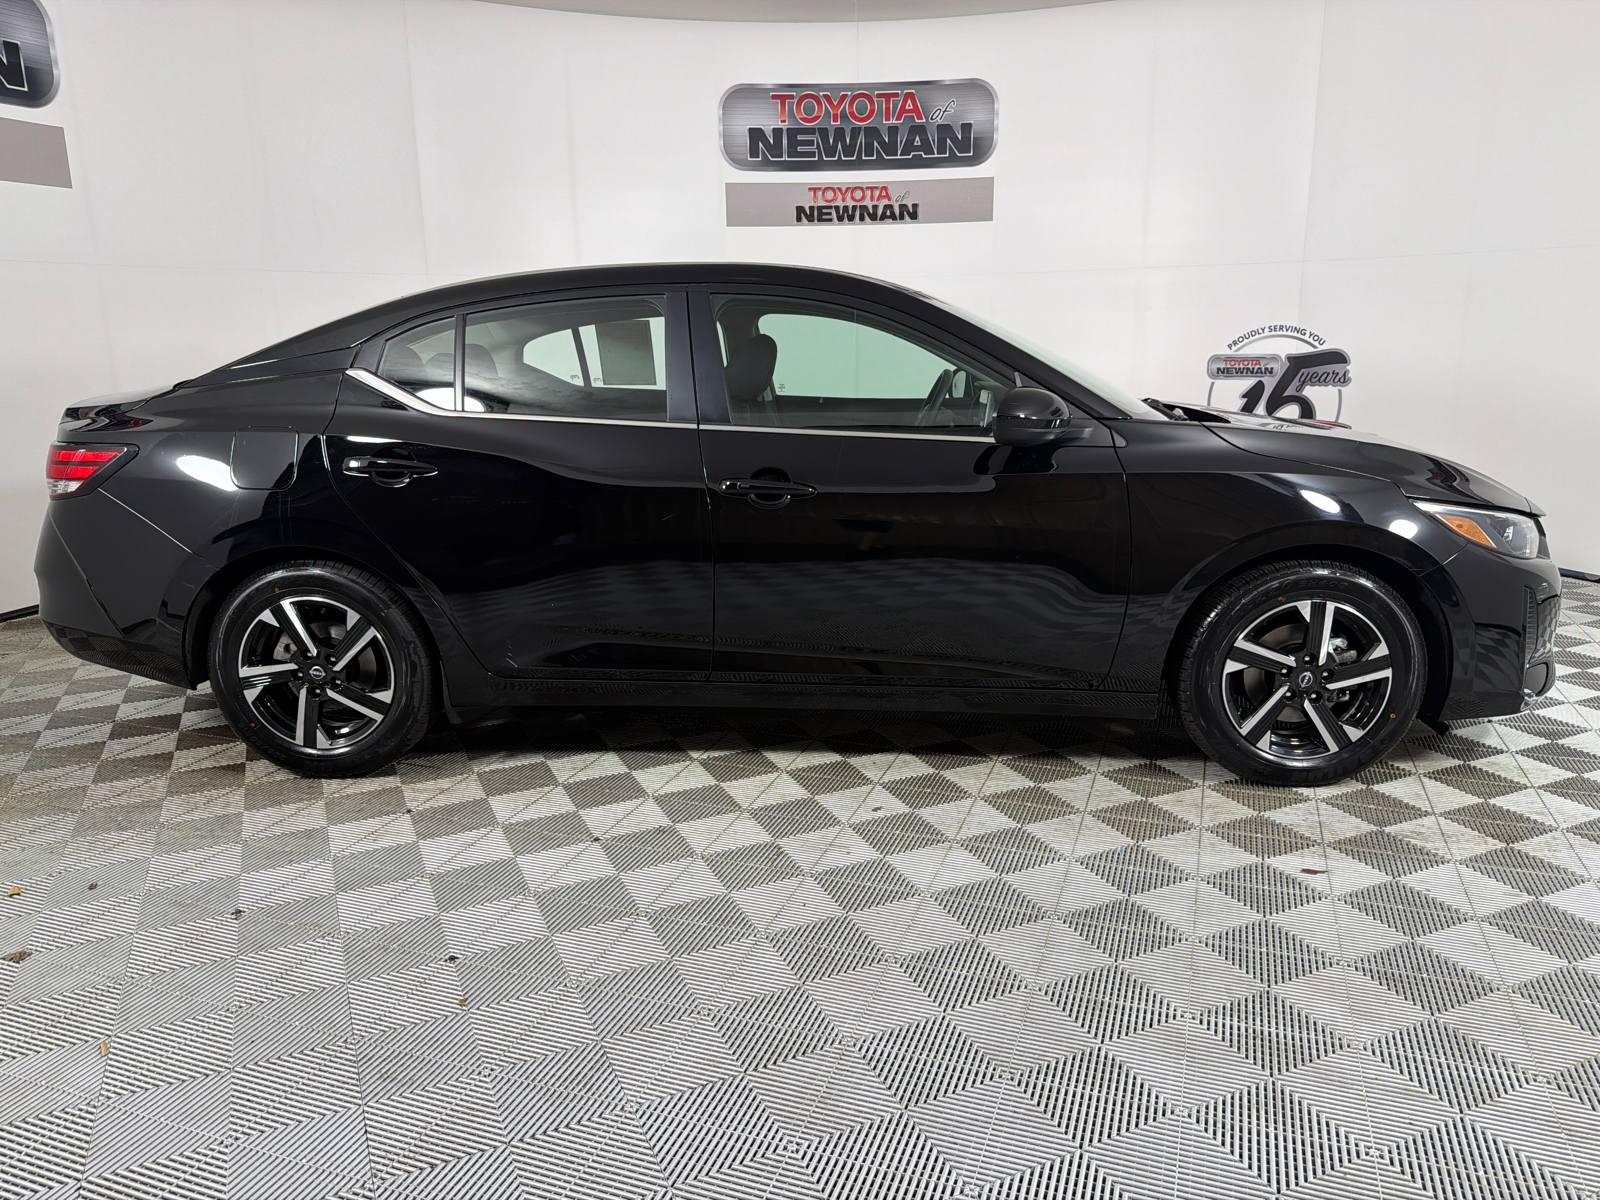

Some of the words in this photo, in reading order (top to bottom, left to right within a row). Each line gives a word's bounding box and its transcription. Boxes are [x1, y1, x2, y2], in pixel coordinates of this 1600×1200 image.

[770, 91, 924, 125] TOYOTA
[929, 99, 956, 122] of
[747, 121, 974, 161] NEWNAN
[808, 185, 892, 204] TOYOTA
[895, 190, 910, 203] of
[795, 203, 919, 223] NEWNAN
[1227, 326, 1266, 351] PROUDLY
[1268, 324, 1307, 336] SERVING
[1308, 331, 1326, 346] YOU
[1216, 367, 1275, 375] NEWNAN
[1223, 359, 1262, 367] TOYOTA
[1240, 351, 1347, 420] 15
[1296, 368, 1349, 393] years
